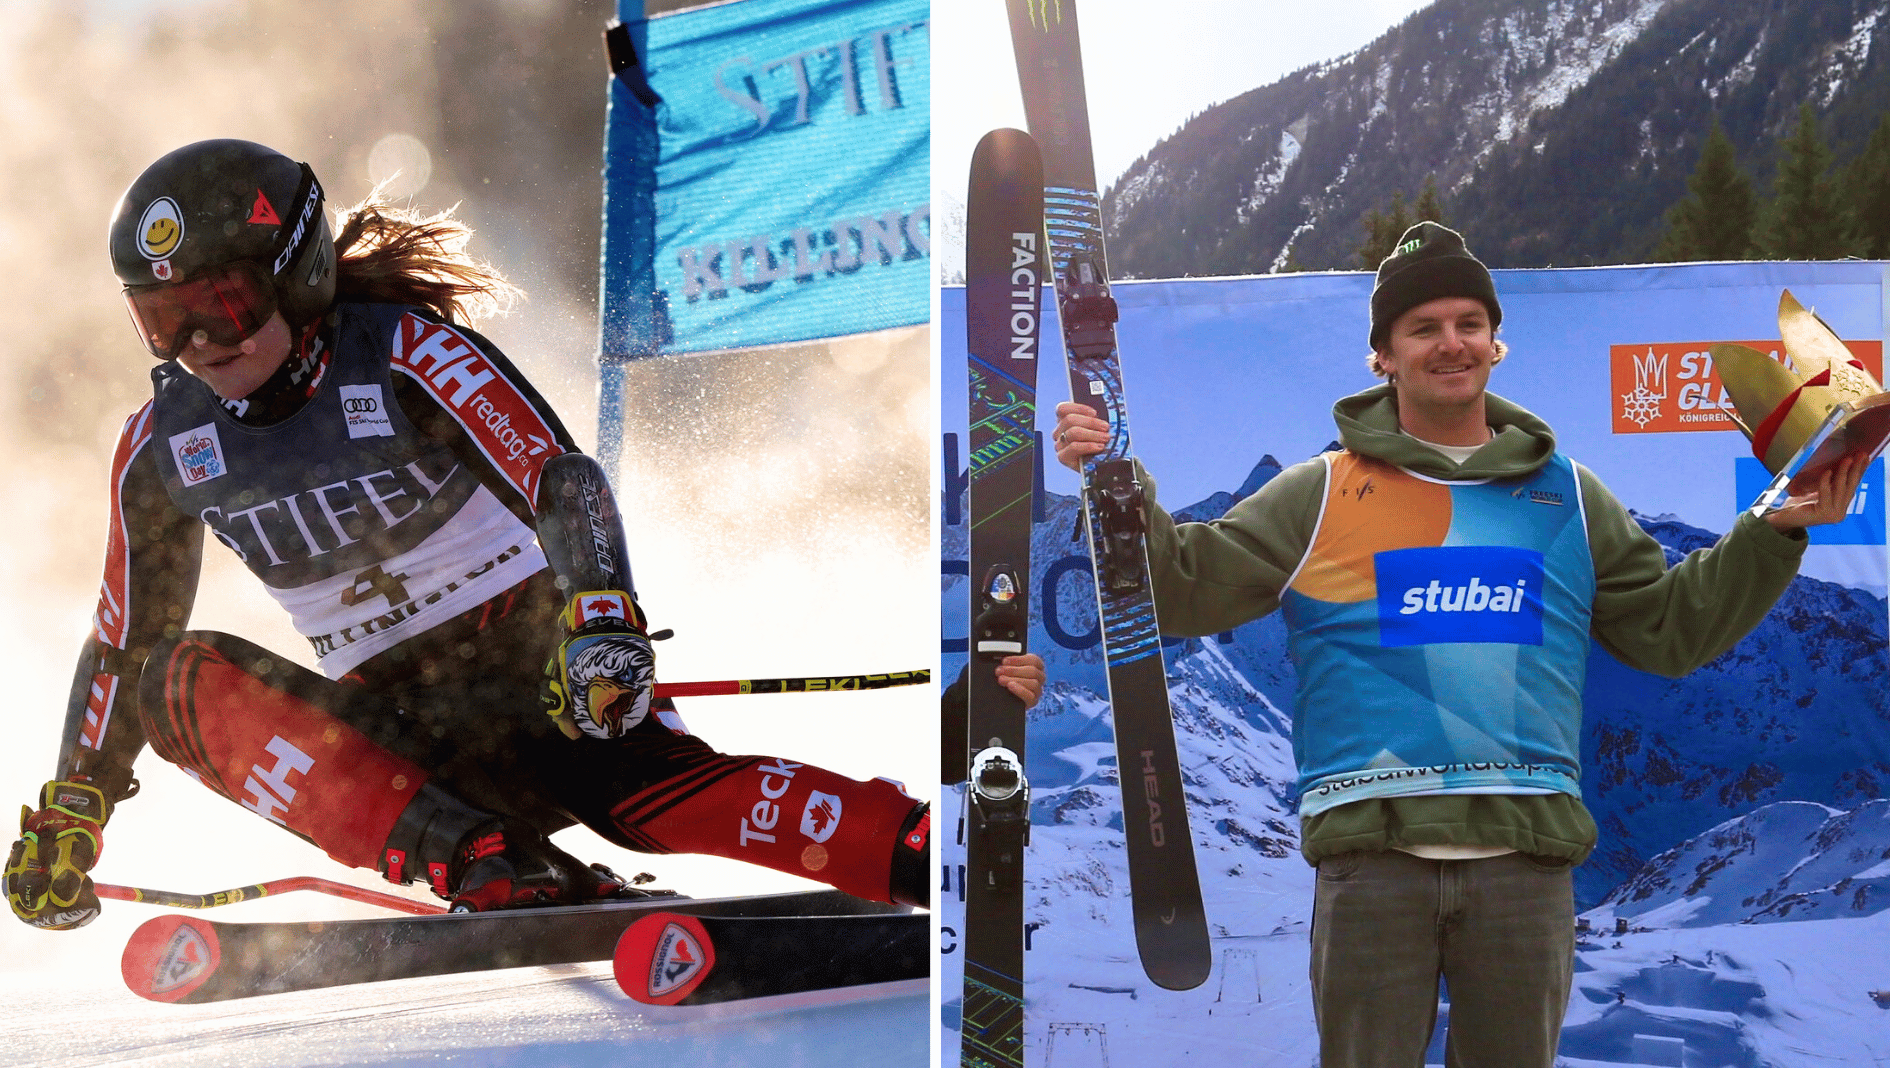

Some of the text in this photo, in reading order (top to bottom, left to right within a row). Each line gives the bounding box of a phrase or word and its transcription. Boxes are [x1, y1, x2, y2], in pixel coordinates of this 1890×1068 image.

[1011, 232, 1036, 360] FACTION
[200, 459, 459, 567] STIFEL
[340, 564, 414, 607] 4
[1399, 577, 1527, 615] stubai
[739, 757, 804, 848] Teck
[1140, 750, 1165, 848] HEAD
[653, 933, 675, 987] ROSSIGNOL
